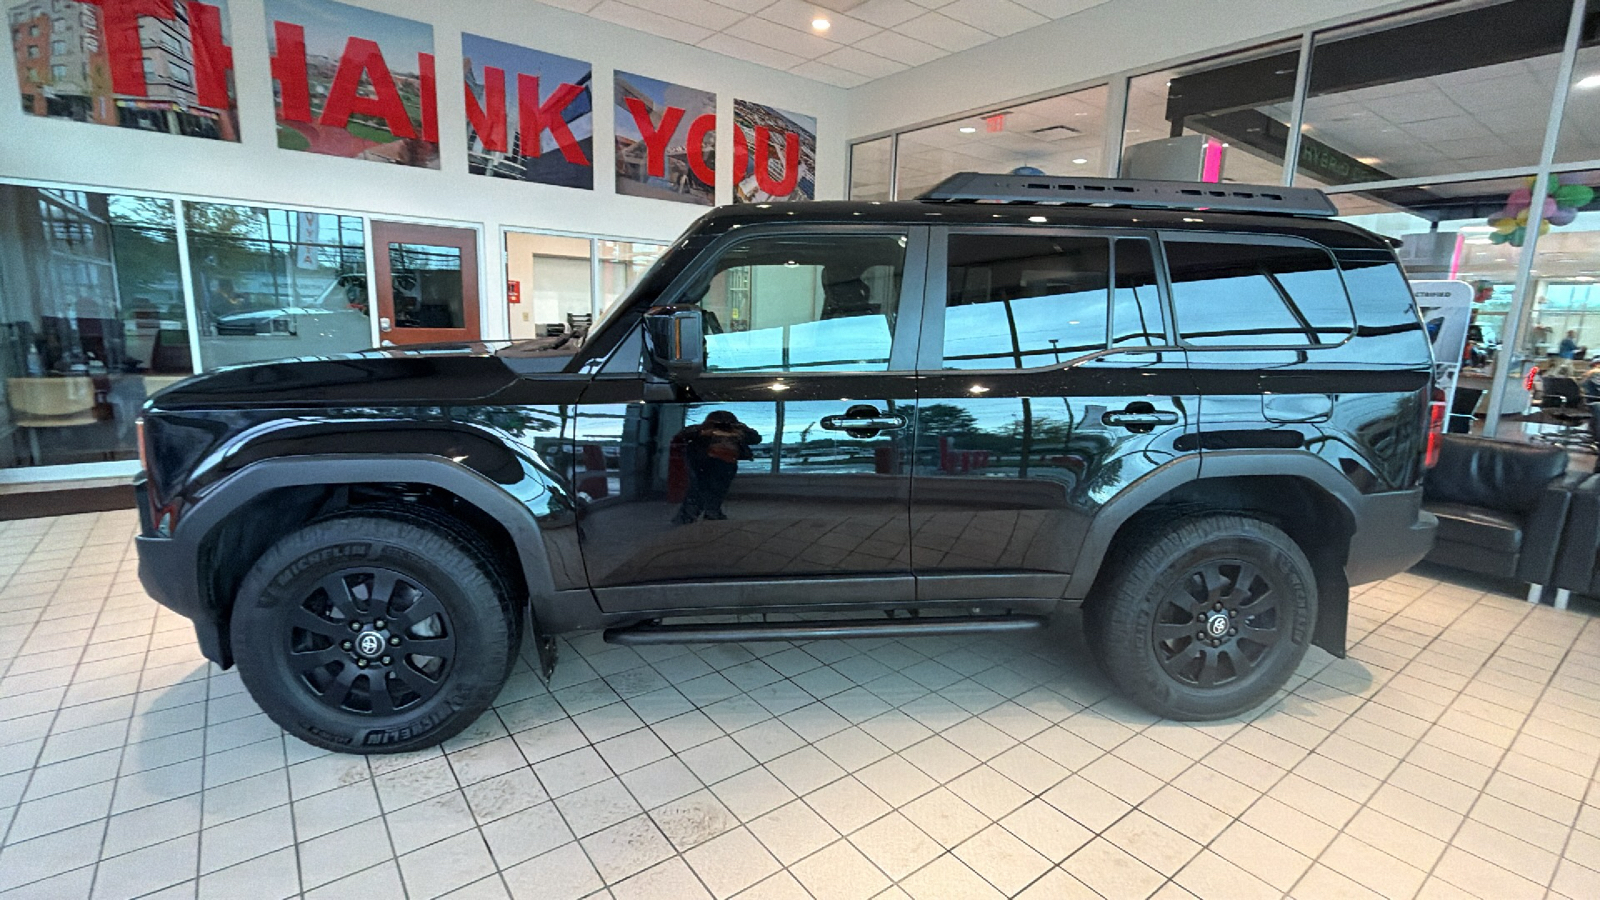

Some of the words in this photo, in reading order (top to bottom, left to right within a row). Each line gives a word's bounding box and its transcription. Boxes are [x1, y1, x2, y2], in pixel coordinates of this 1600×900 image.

[72, 0, 590, 166] THANK
[624, 96, 799, 197] YOU
[278, 544, 367, 586] MICHELIN
